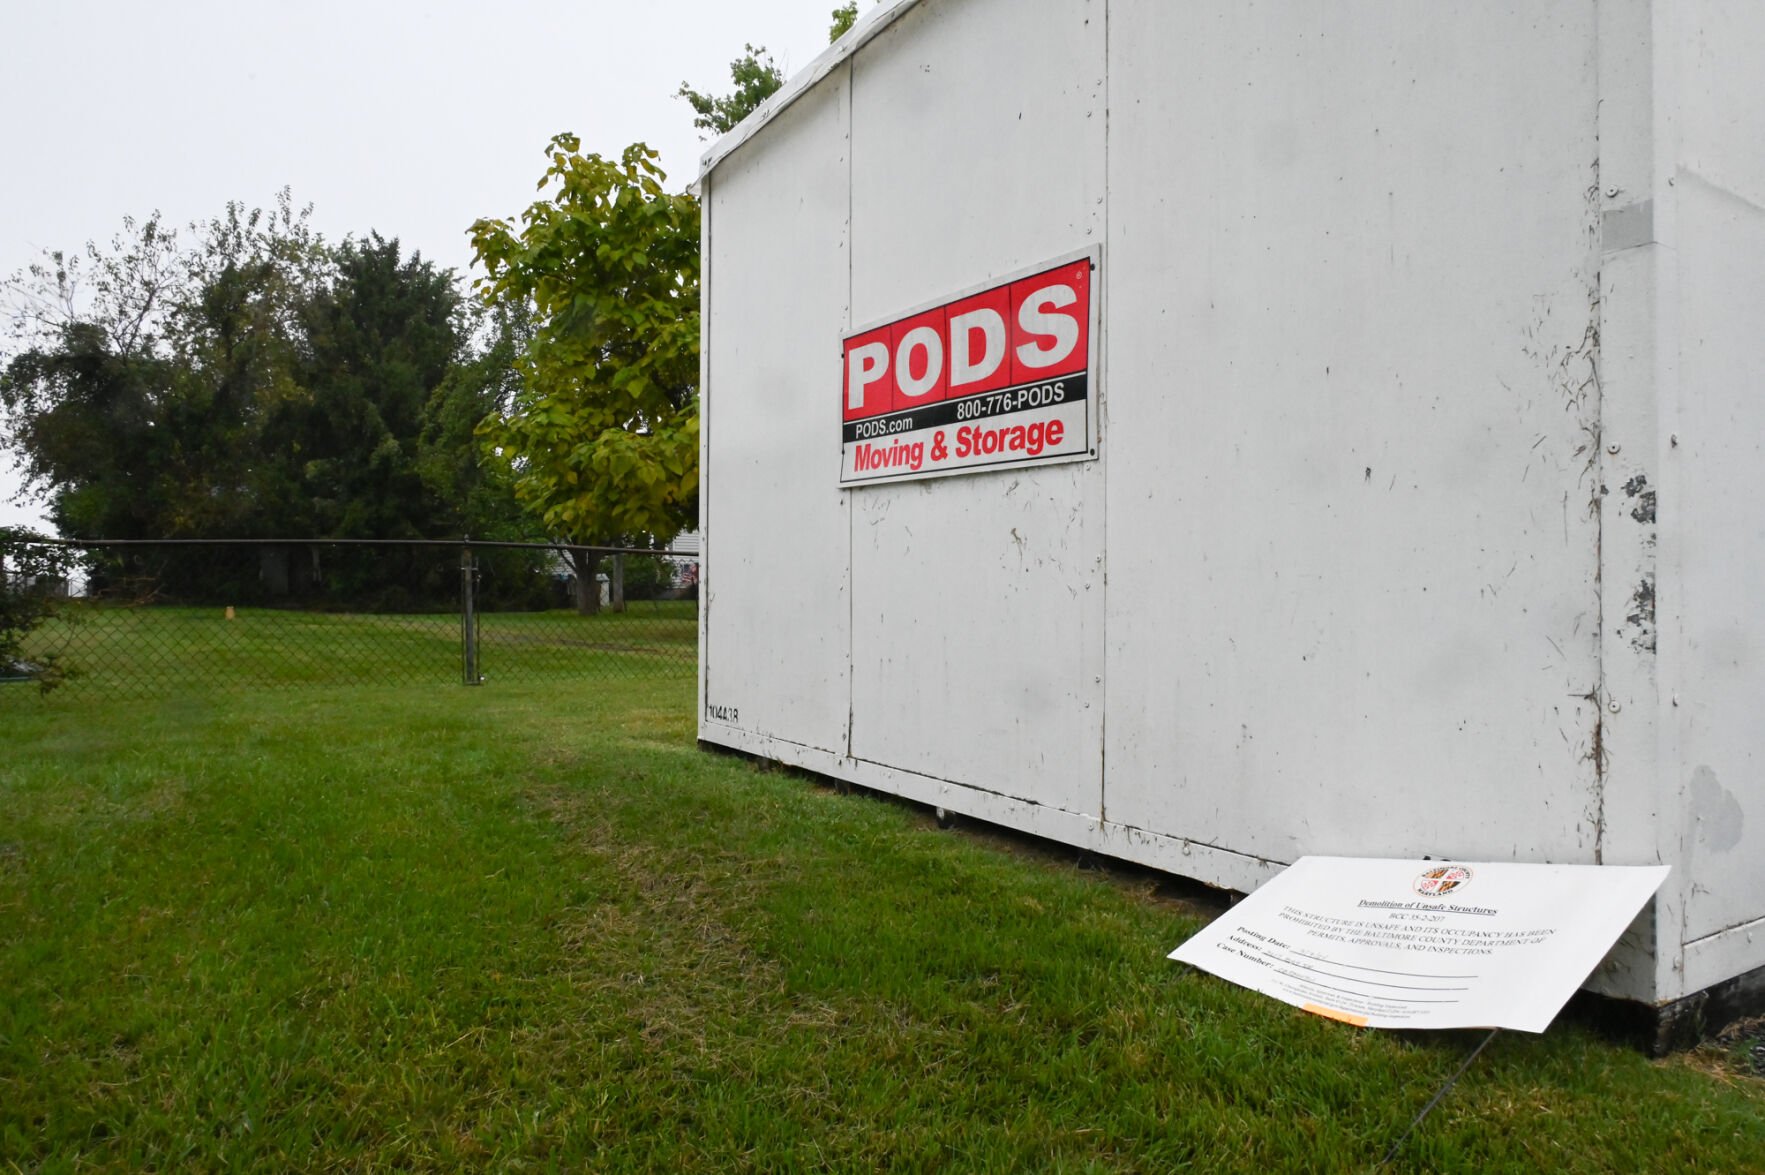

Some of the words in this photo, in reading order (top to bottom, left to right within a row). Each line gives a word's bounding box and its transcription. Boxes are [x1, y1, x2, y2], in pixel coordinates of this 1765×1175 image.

[848, 284, 1079, 410] PODS
[856, 417, 913, 439] PODS.com
[957, 383, 1065, 420] 800-776-PODS
[854, 439, 923, 472] Moving
[930, 430, 948, 461] &
[955, 419, 1064, 457] Storage
[1359, 899, 1403, 909] Demolition
[1416, 902, 1446, 911] Unsafe
[1448, 904, 1498, 915] Structures
[1228, 935, 1263, 951] Address:
[1237, 926, 1267, 942] Posting
[1267, 937, 1291, 949] Date:
[1217, 942, 1236, 954] Case
[1239, 950, 1275, 968] Number:
